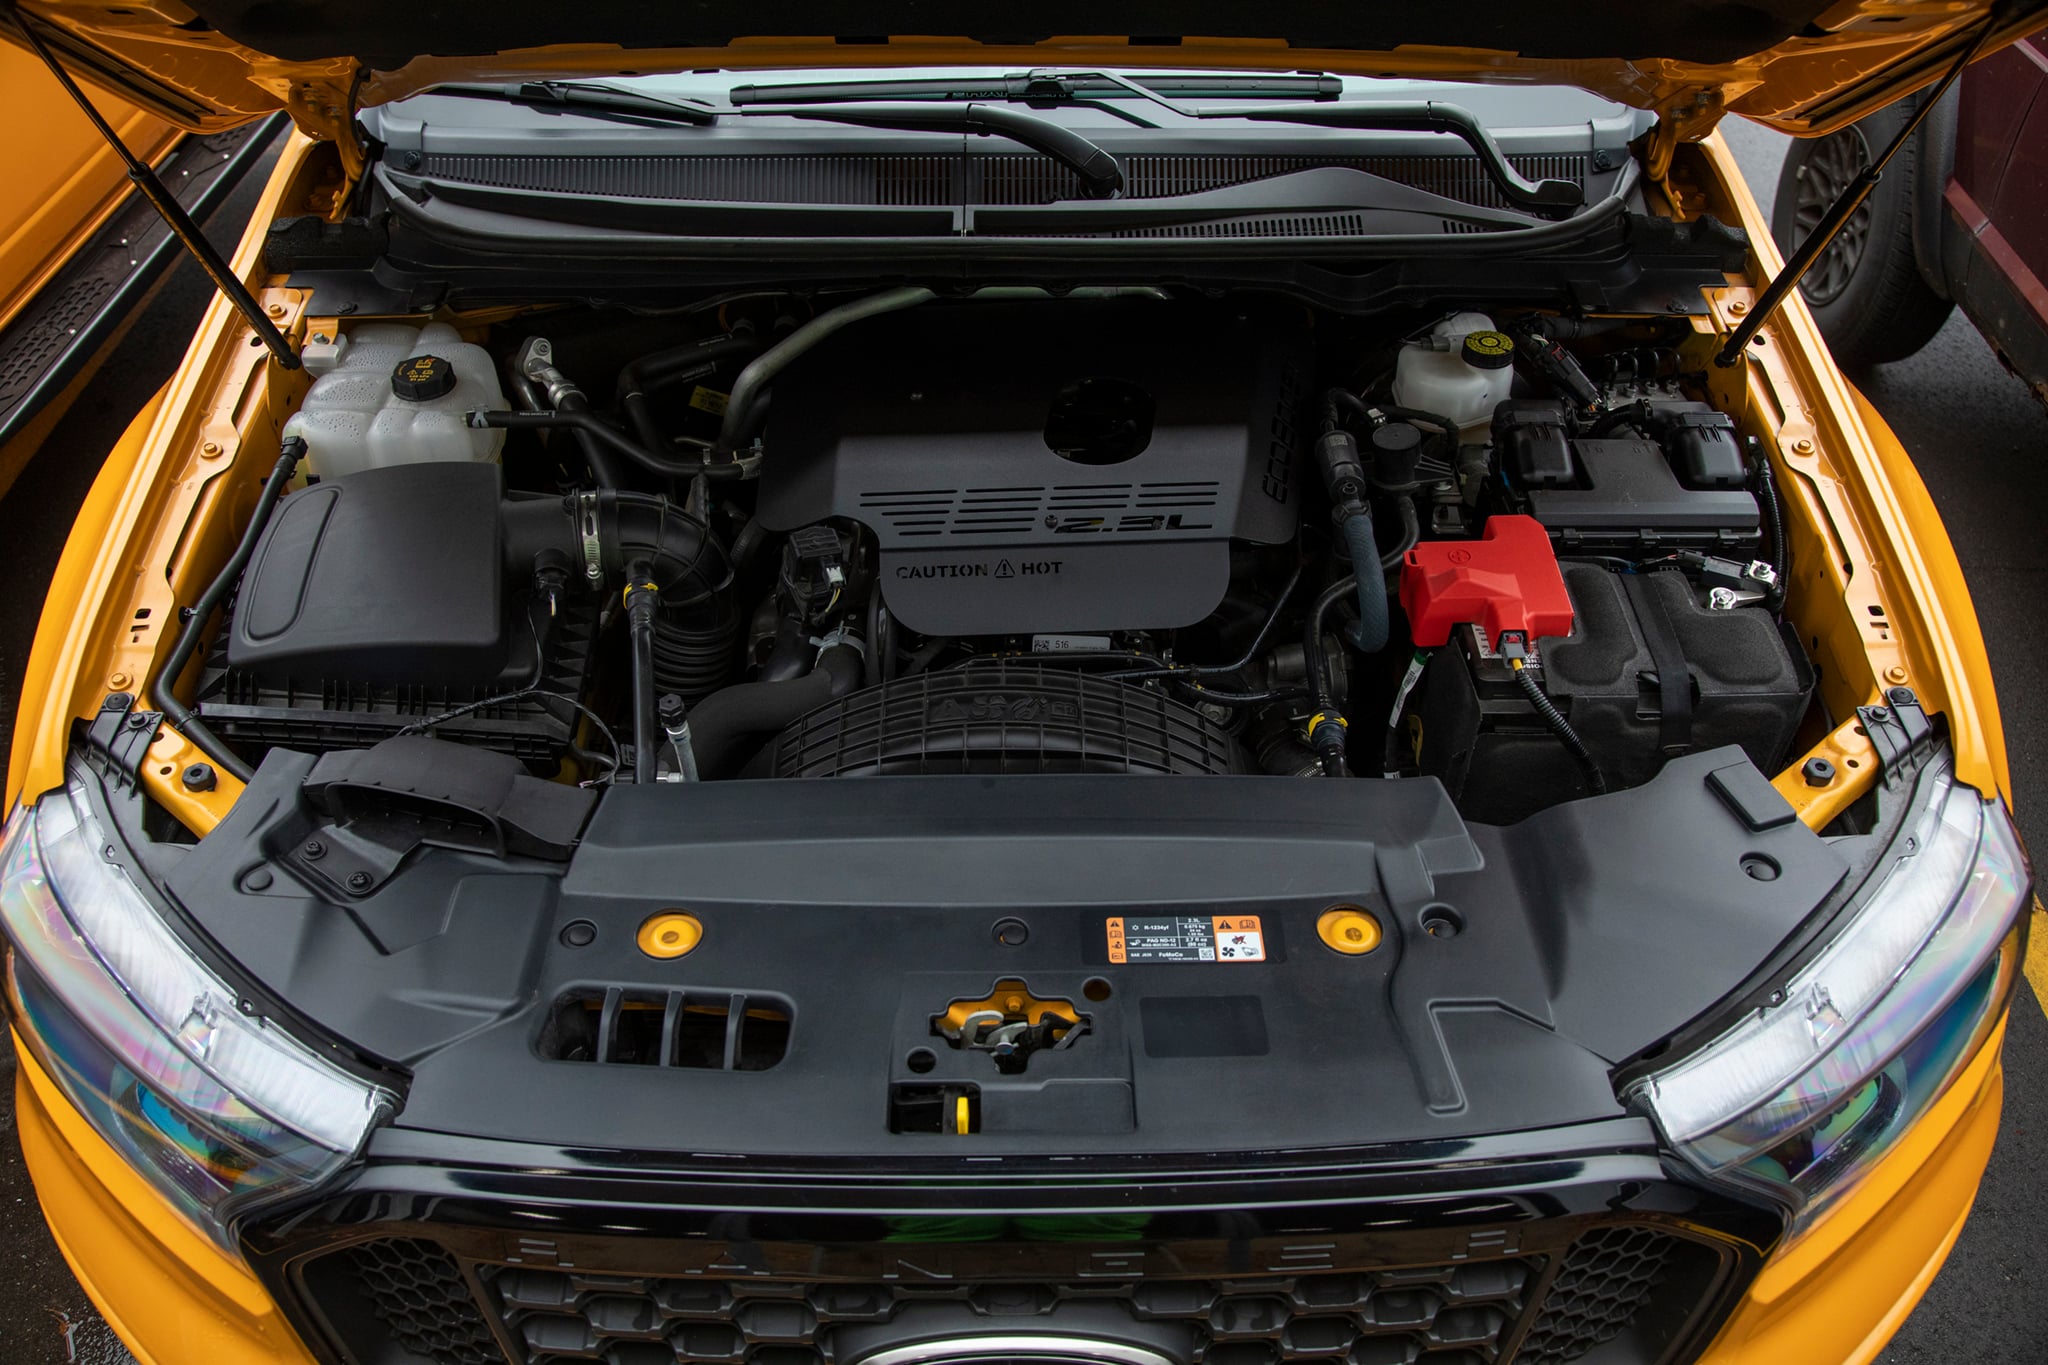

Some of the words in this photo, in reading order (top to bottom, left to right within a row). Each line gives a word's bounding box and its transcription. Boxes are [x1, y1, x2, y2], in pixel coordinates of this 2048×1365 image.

[1054, 514, 1213, 534] 2.3L
[896, 563, 988, 579] CAUTION
[1021, 561, 1063, 575] HOT
[1055, 640, 1069, 649] 516
